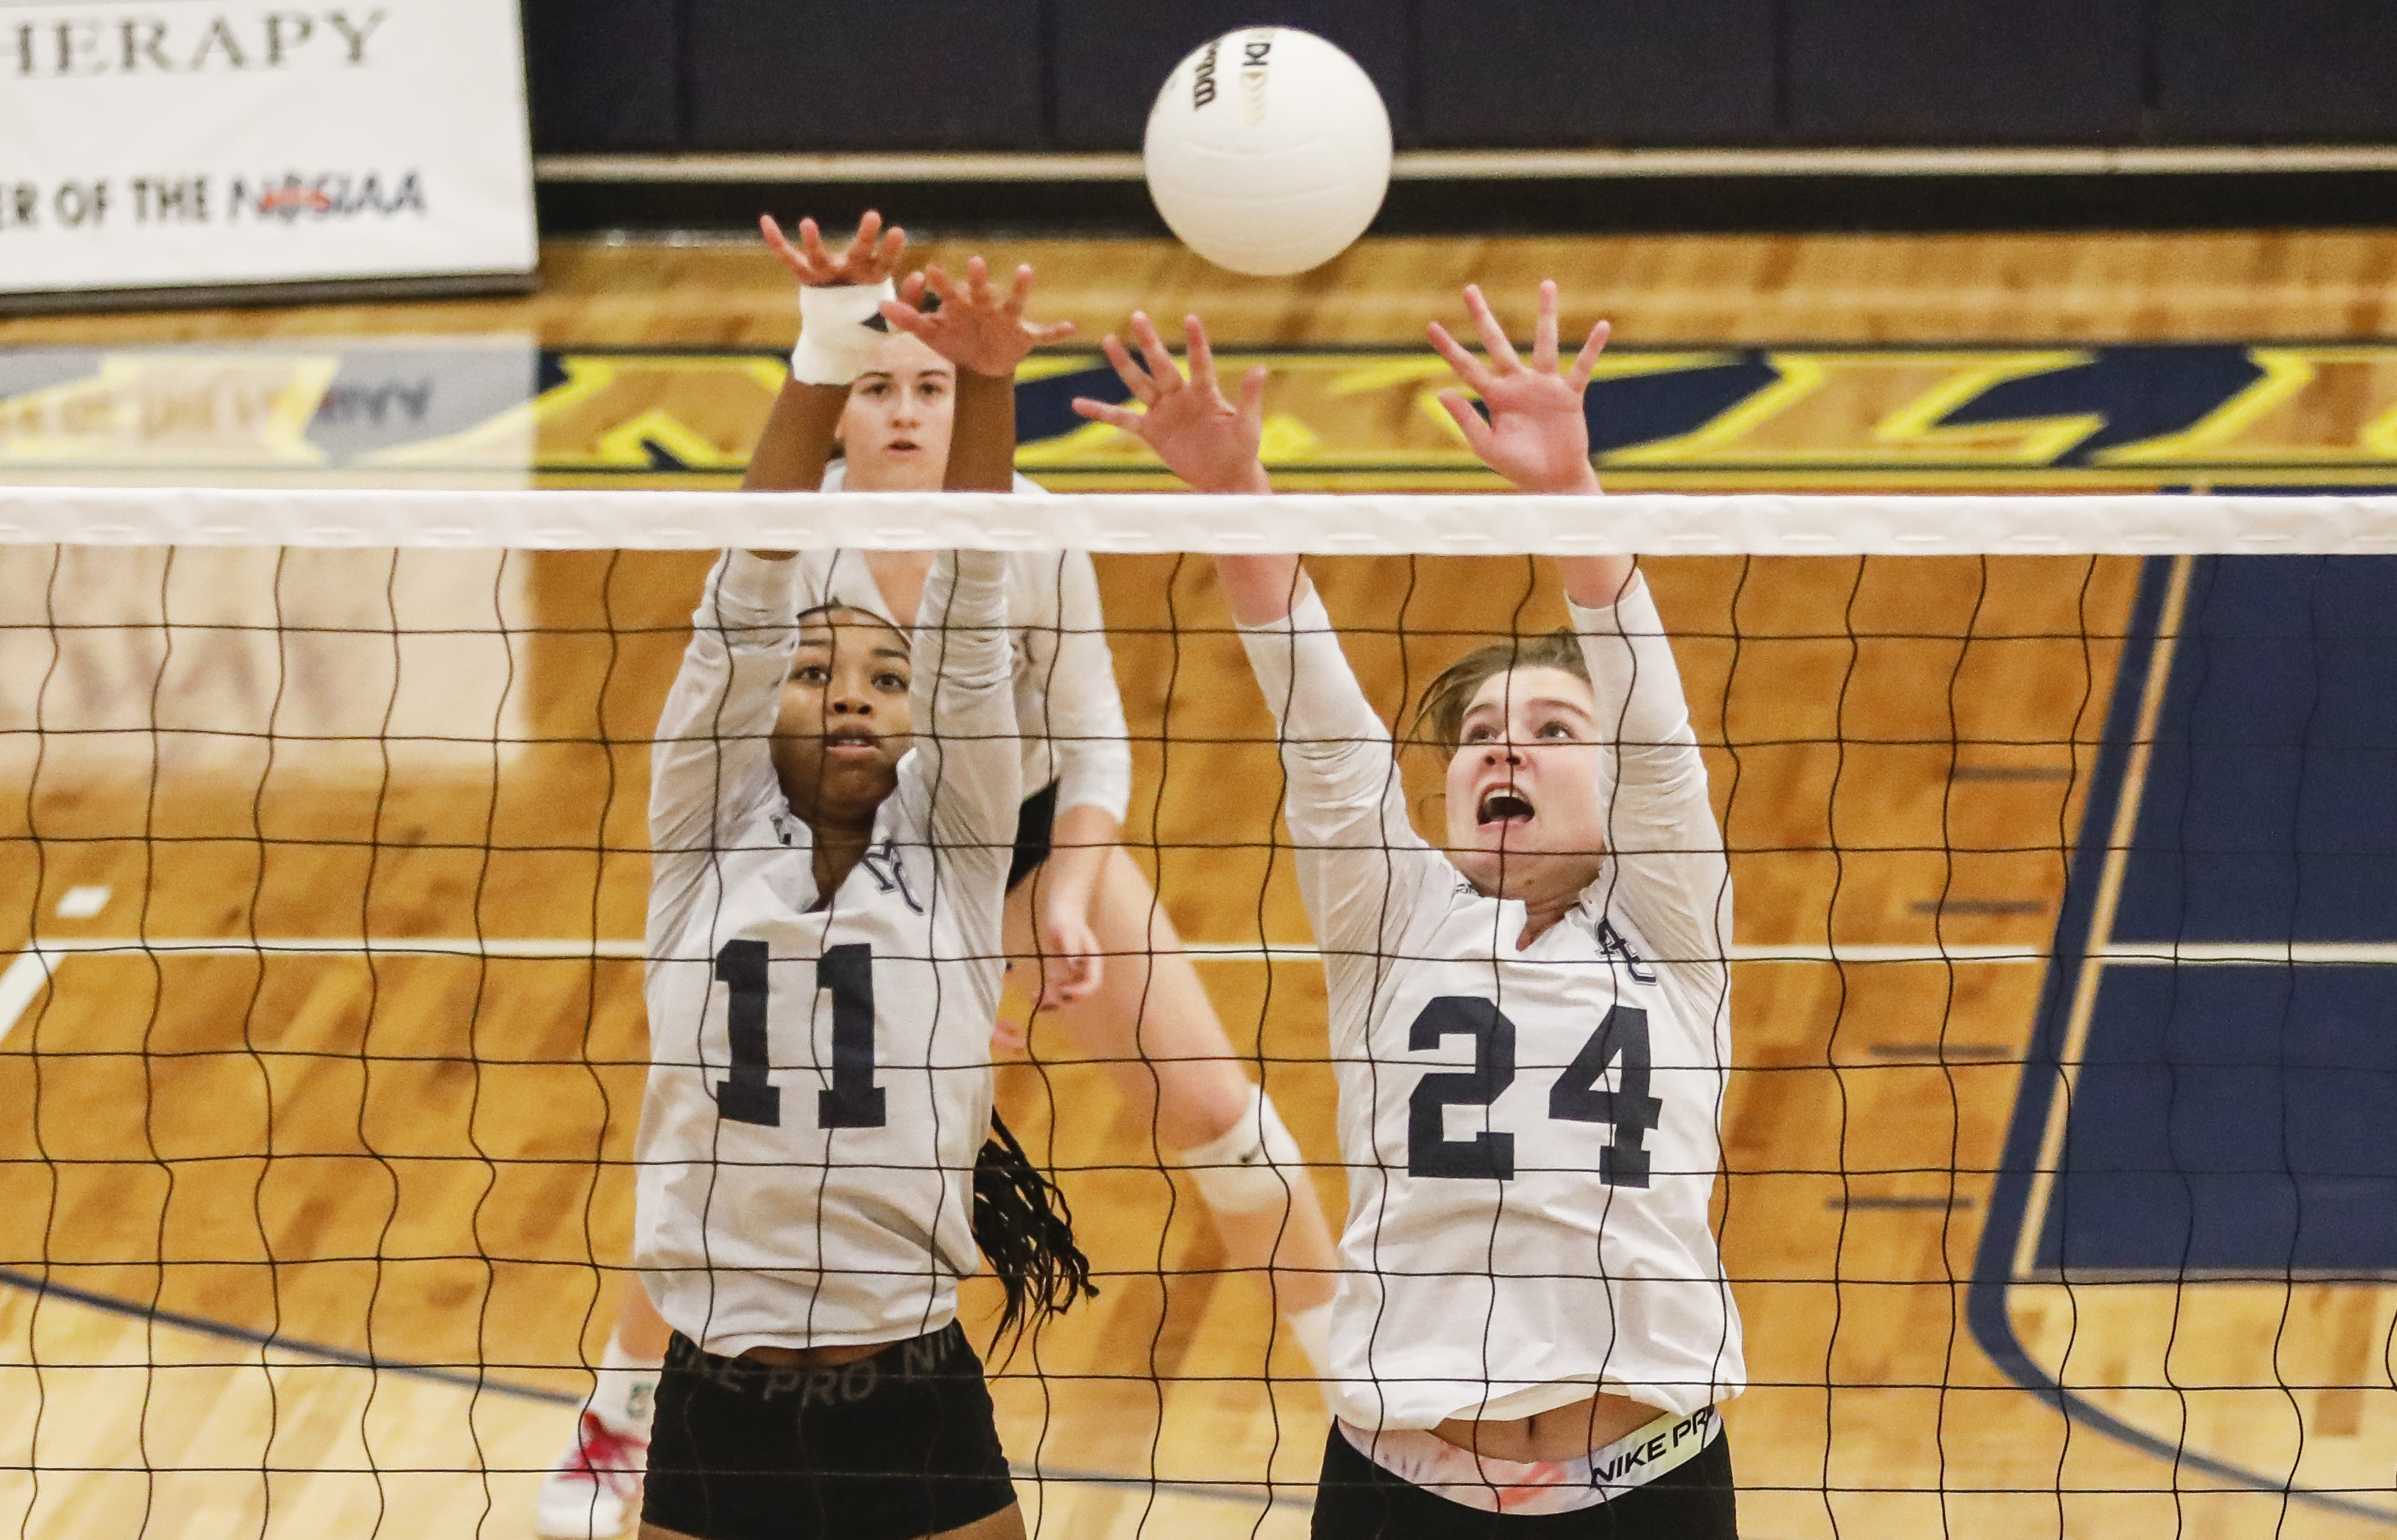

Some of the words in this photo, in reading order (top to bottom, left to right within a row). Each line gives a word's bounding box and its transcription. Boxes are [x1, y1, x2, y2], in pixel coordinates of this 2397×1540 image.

[0, 179, 39, 229] R
[53, 177, 109, 229] OF
[131, 174, 210, 223] THE
[714, 939, 886, 1128] 11
[1408, 996, 1663, 1188] 24
[761, 1360, 878, 1405] PRO
[1590, 1432, 1667, 1487] NIKE
